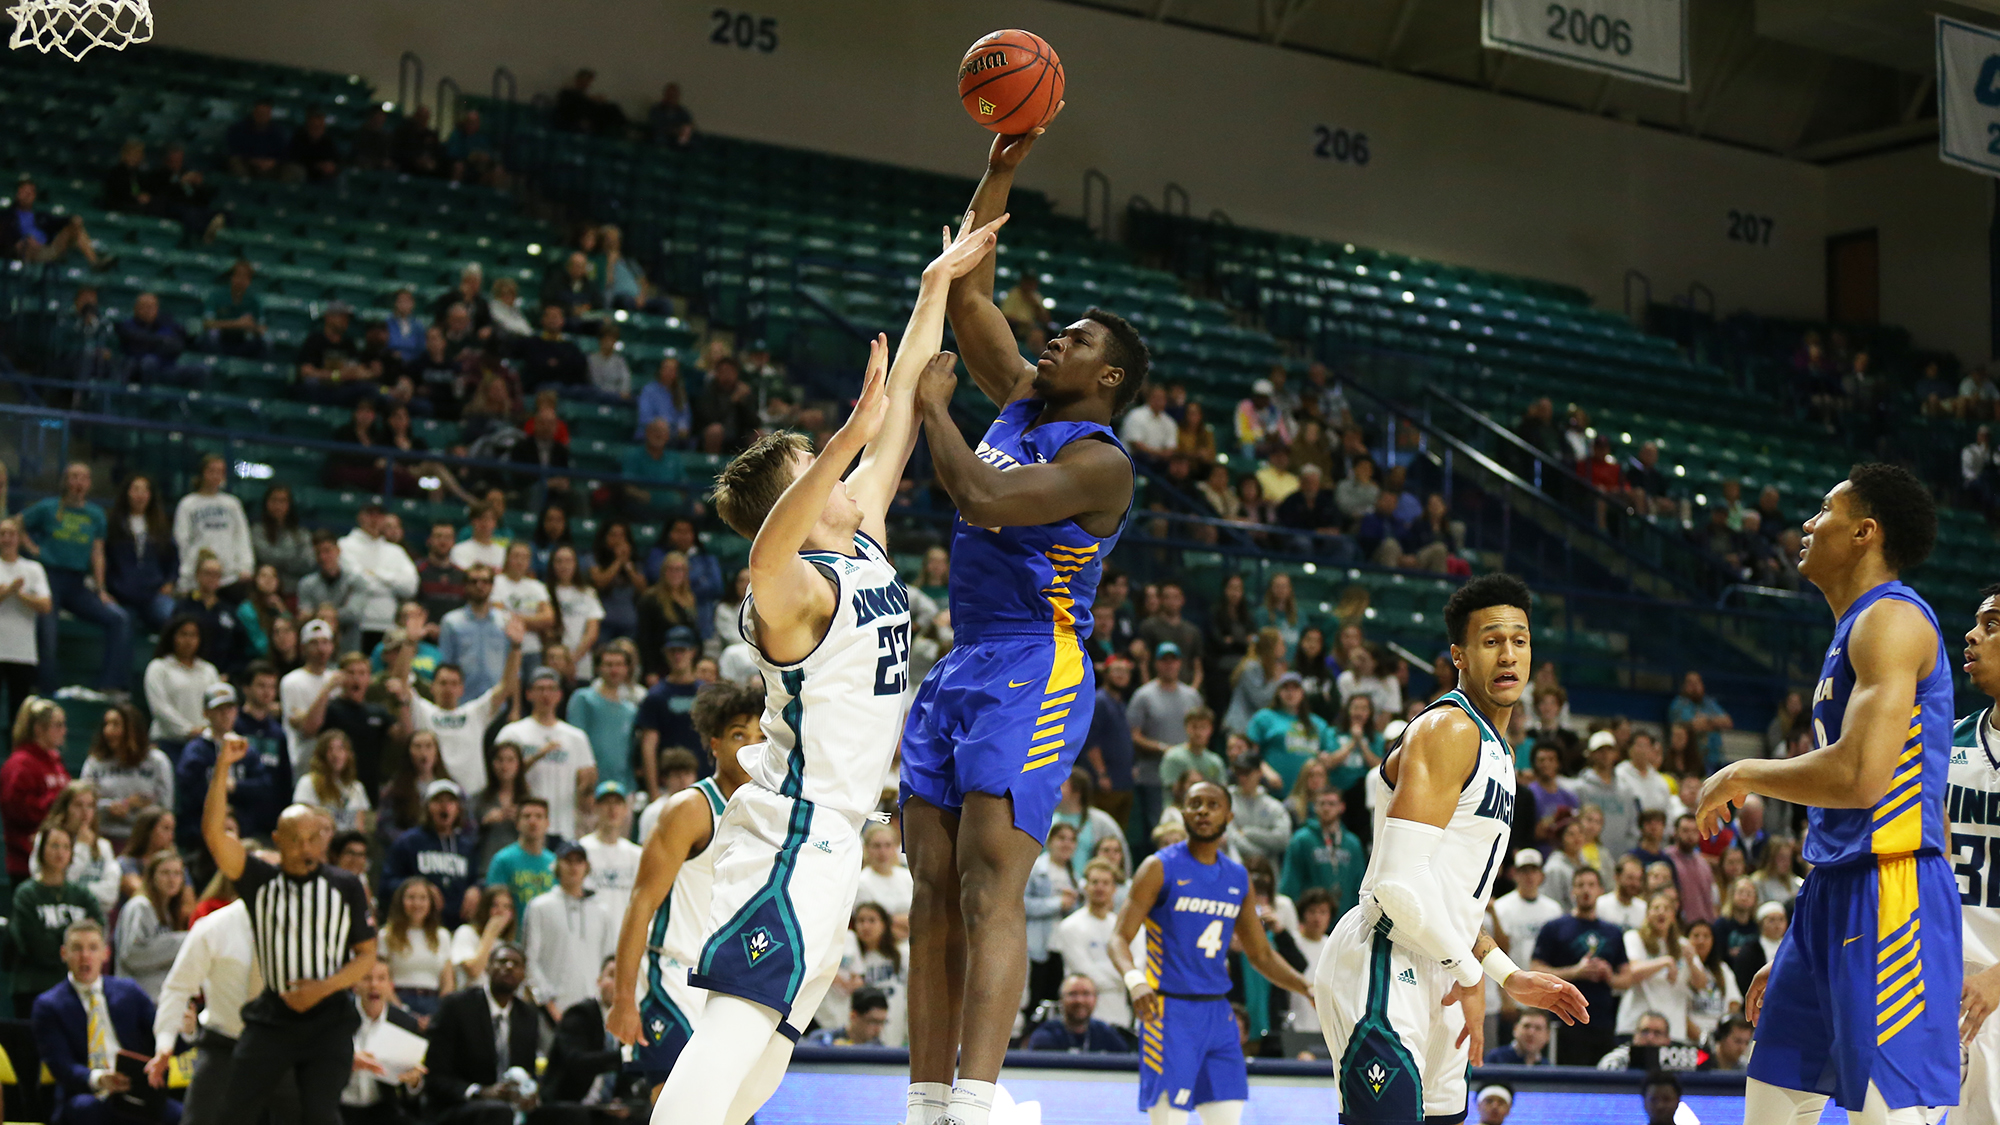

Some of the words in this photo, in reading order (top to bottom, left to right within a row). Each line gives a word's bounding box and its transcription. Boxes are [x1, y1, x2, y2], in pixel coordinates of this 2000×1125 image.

[710, 8, 779, 53] 205
[1546, 3, 1632, 56] 2006
[1314, 125, 1370, 166] 206
[1727, 209, 1774, 245] 207
[873, 621, 910, 696] 23
[417, 851, 468, 877] UNCW
[1472, 832, 1502, 899] 1
[1196, 919, 1224, 958] 4
[1659, 1046, 1698, 1067] POSS
